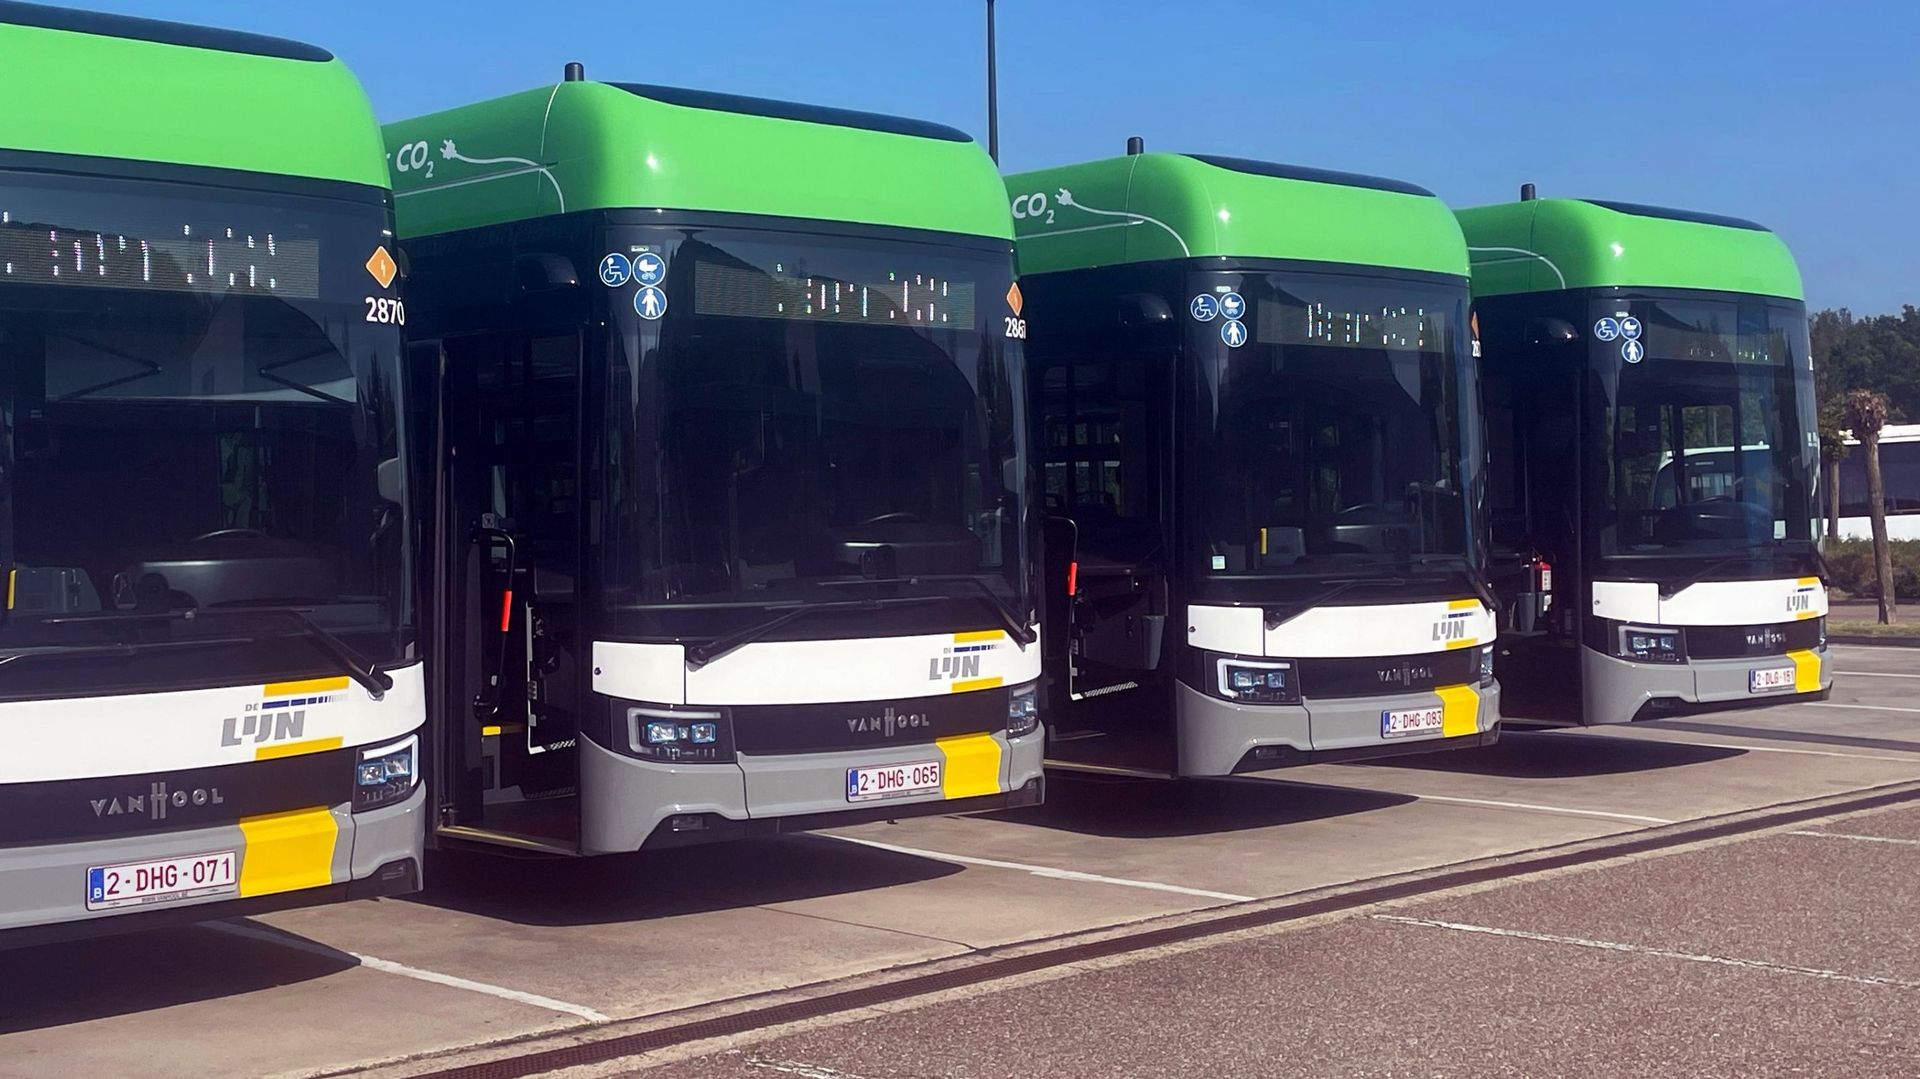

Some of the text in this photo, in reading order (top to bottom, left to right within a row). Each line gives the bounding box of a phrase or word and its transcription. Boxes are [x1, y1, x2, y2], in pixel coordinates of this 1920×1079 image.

[365, 297, 405, 325] 2870
[1432, 620, 1465, 641] LIJN
[929, 655, 980, 680] LIJN
[245, 703, 259, 711] DE
[221, 710, 306, 747] LIJN
[860, 766, 938, 791] 2-DHG-065
[107, 858, 229, 895] 2-DHG-071
[94, 888, 102, 898] B
